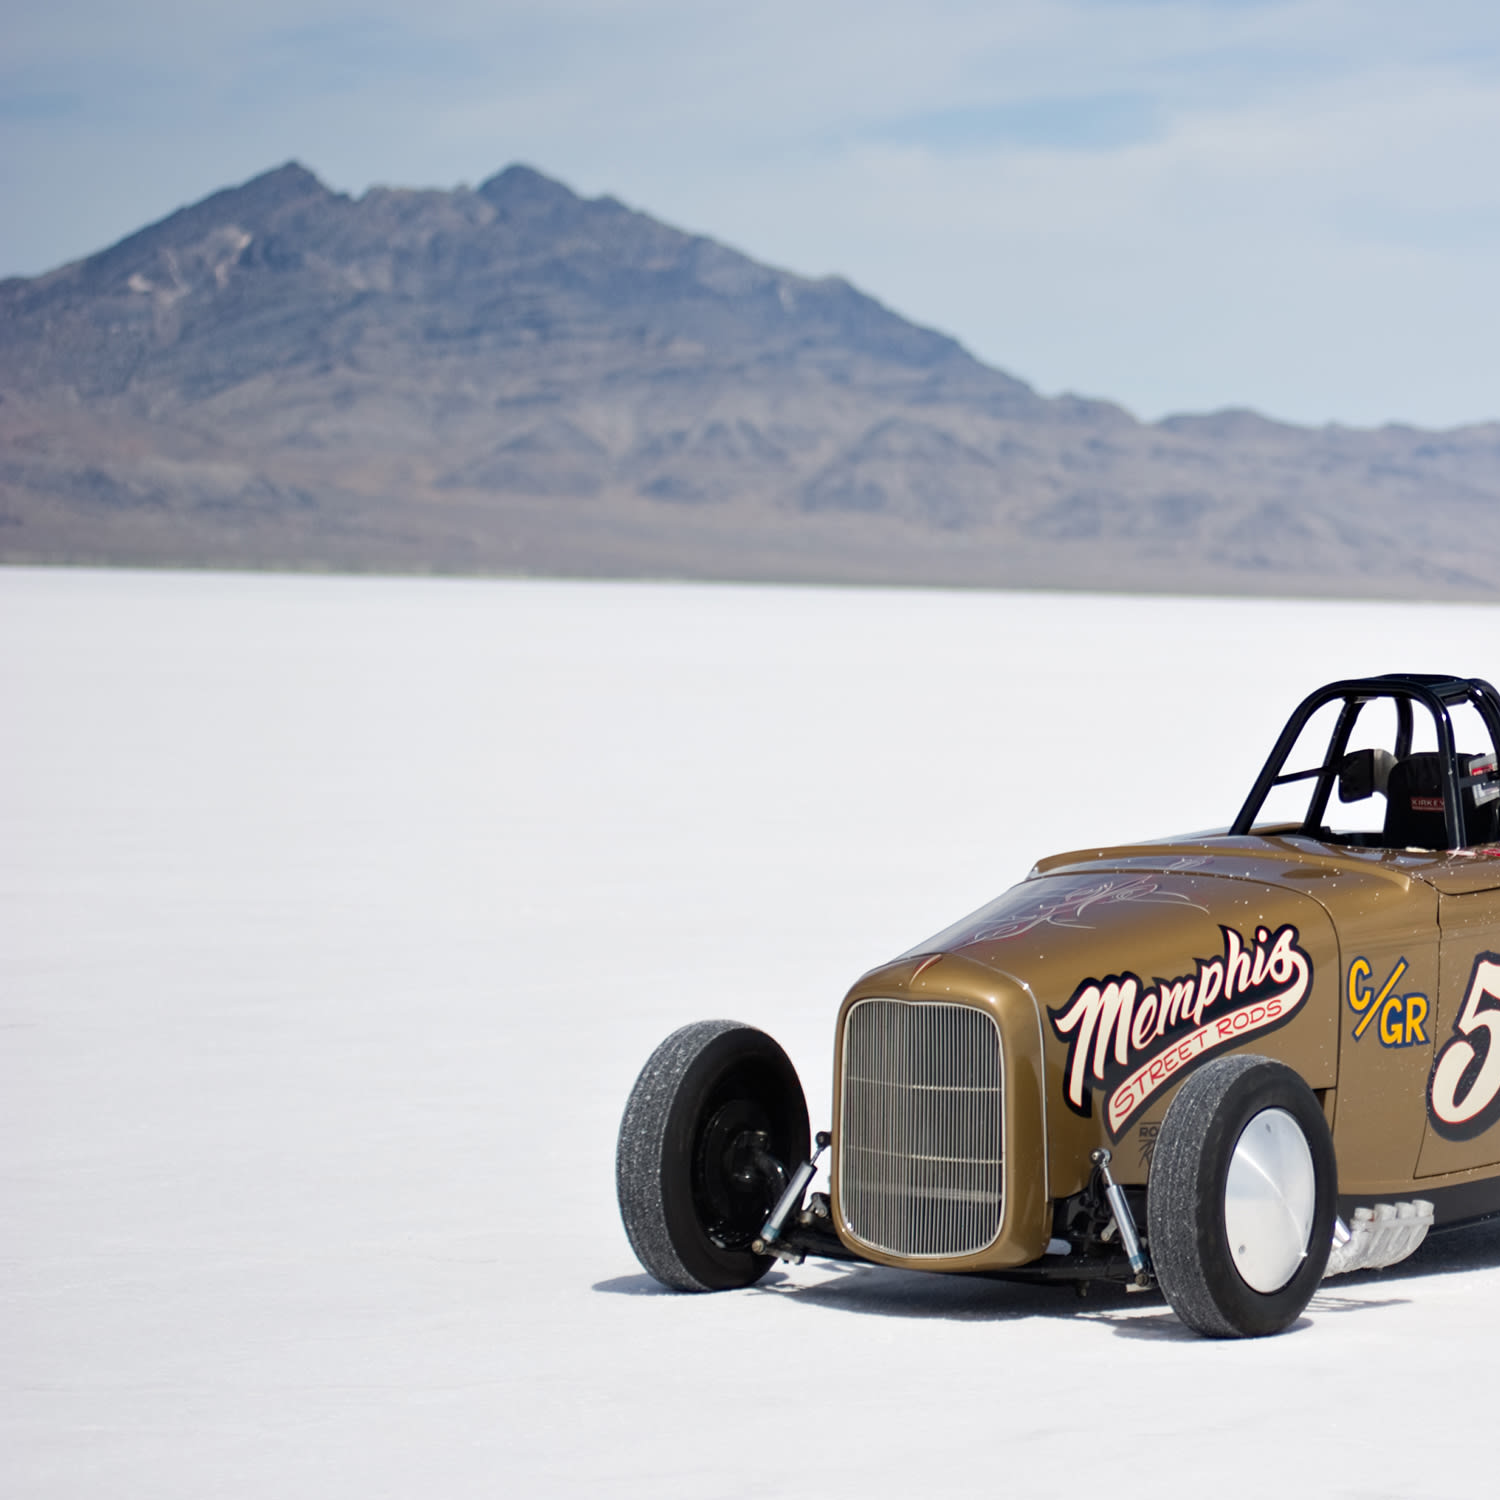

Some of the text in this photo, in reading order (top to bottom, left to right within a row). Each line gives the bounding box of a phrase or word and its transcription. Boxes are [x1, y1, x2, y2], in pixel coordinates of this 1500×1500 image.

[1055, 928, 1310, 1108] Memphis
[1113, 999, 1284, 1118] STREET RODS
[1348, 956, 1428, 1045] C/GR
